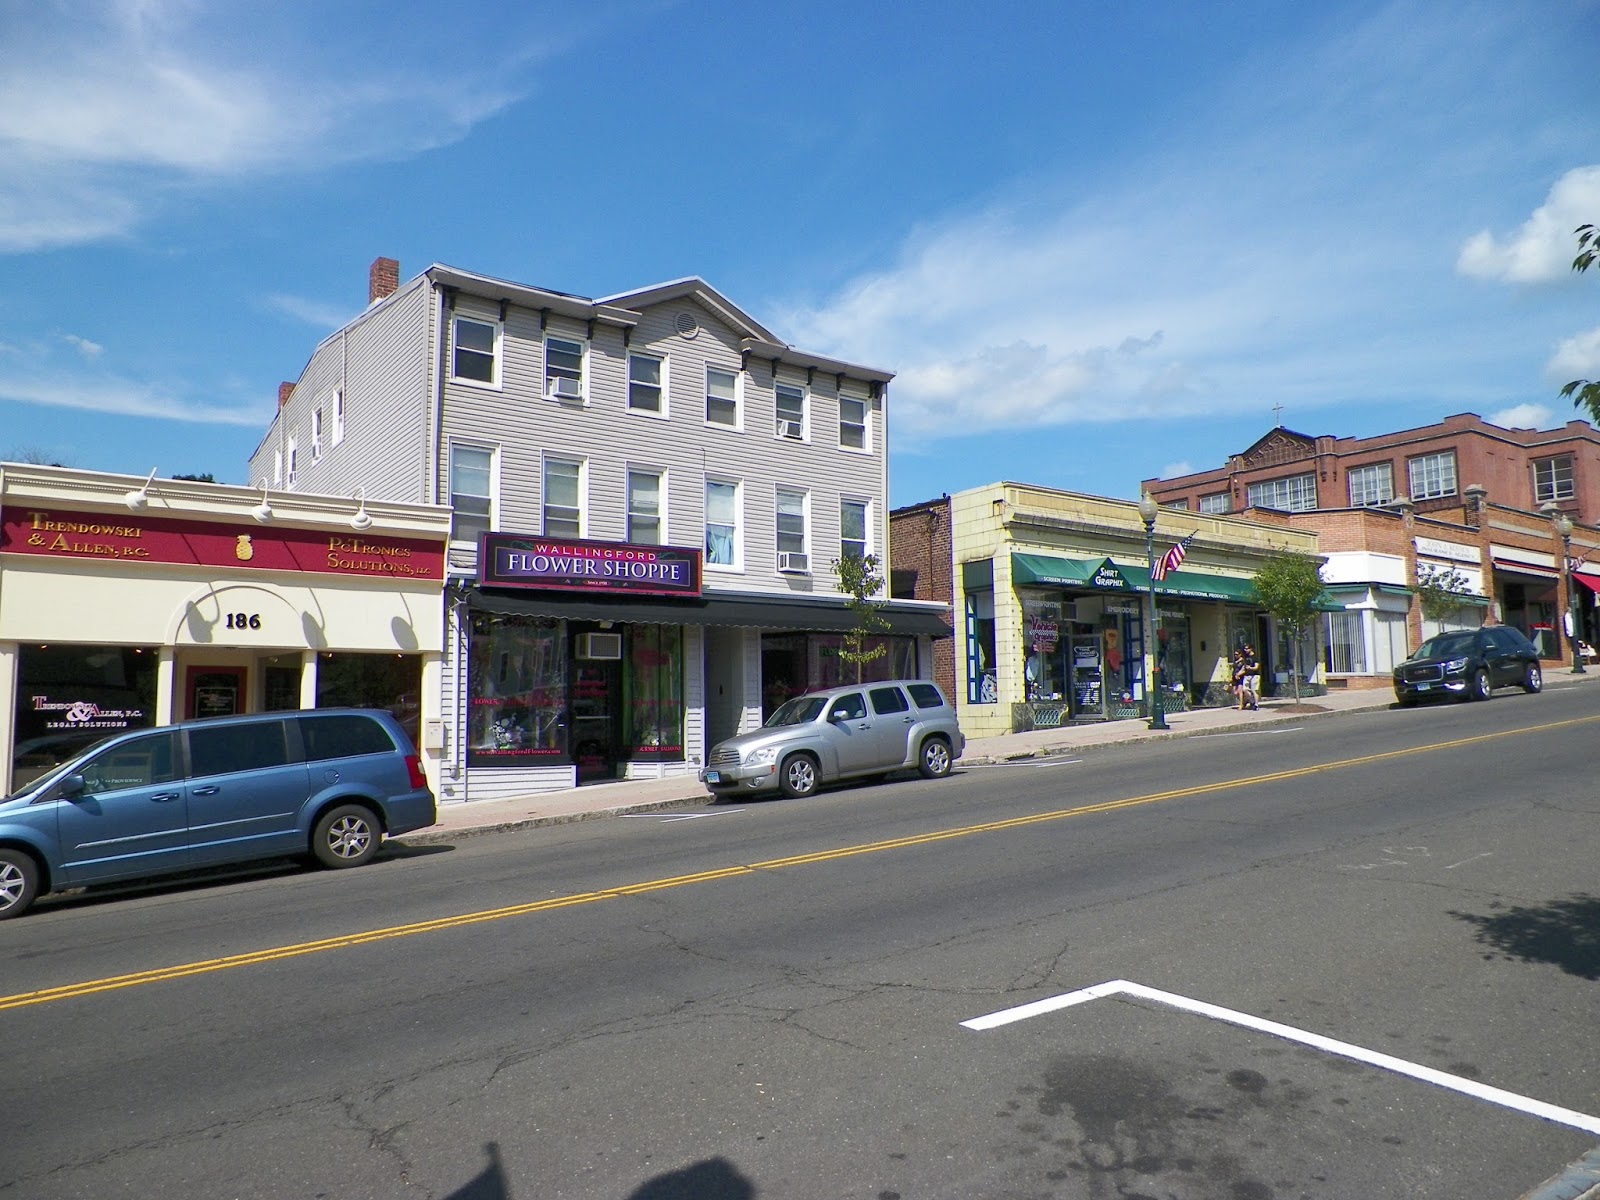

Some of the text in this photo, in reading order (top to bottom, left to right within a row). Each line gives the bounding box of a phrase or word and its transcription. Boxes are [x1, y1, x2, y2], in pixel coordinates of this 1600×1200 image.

[28, 512, 142, 538] TRENDOWSKI
[28, 533, 46, 546] &
[48, 533, 120, 557] ALLEN,
[536, 544, 656, 561] WALLINGFORD
[327, 553, 431, 576] SOLUTIONS, LLC
[508, 554, 680, 580] FLOWER SHOPPE
[1100, 567, 1118, 577] SHIRT
[1095, 576, 1123, 587] GRAPHIX
[226, 613, 262, 630] 186
